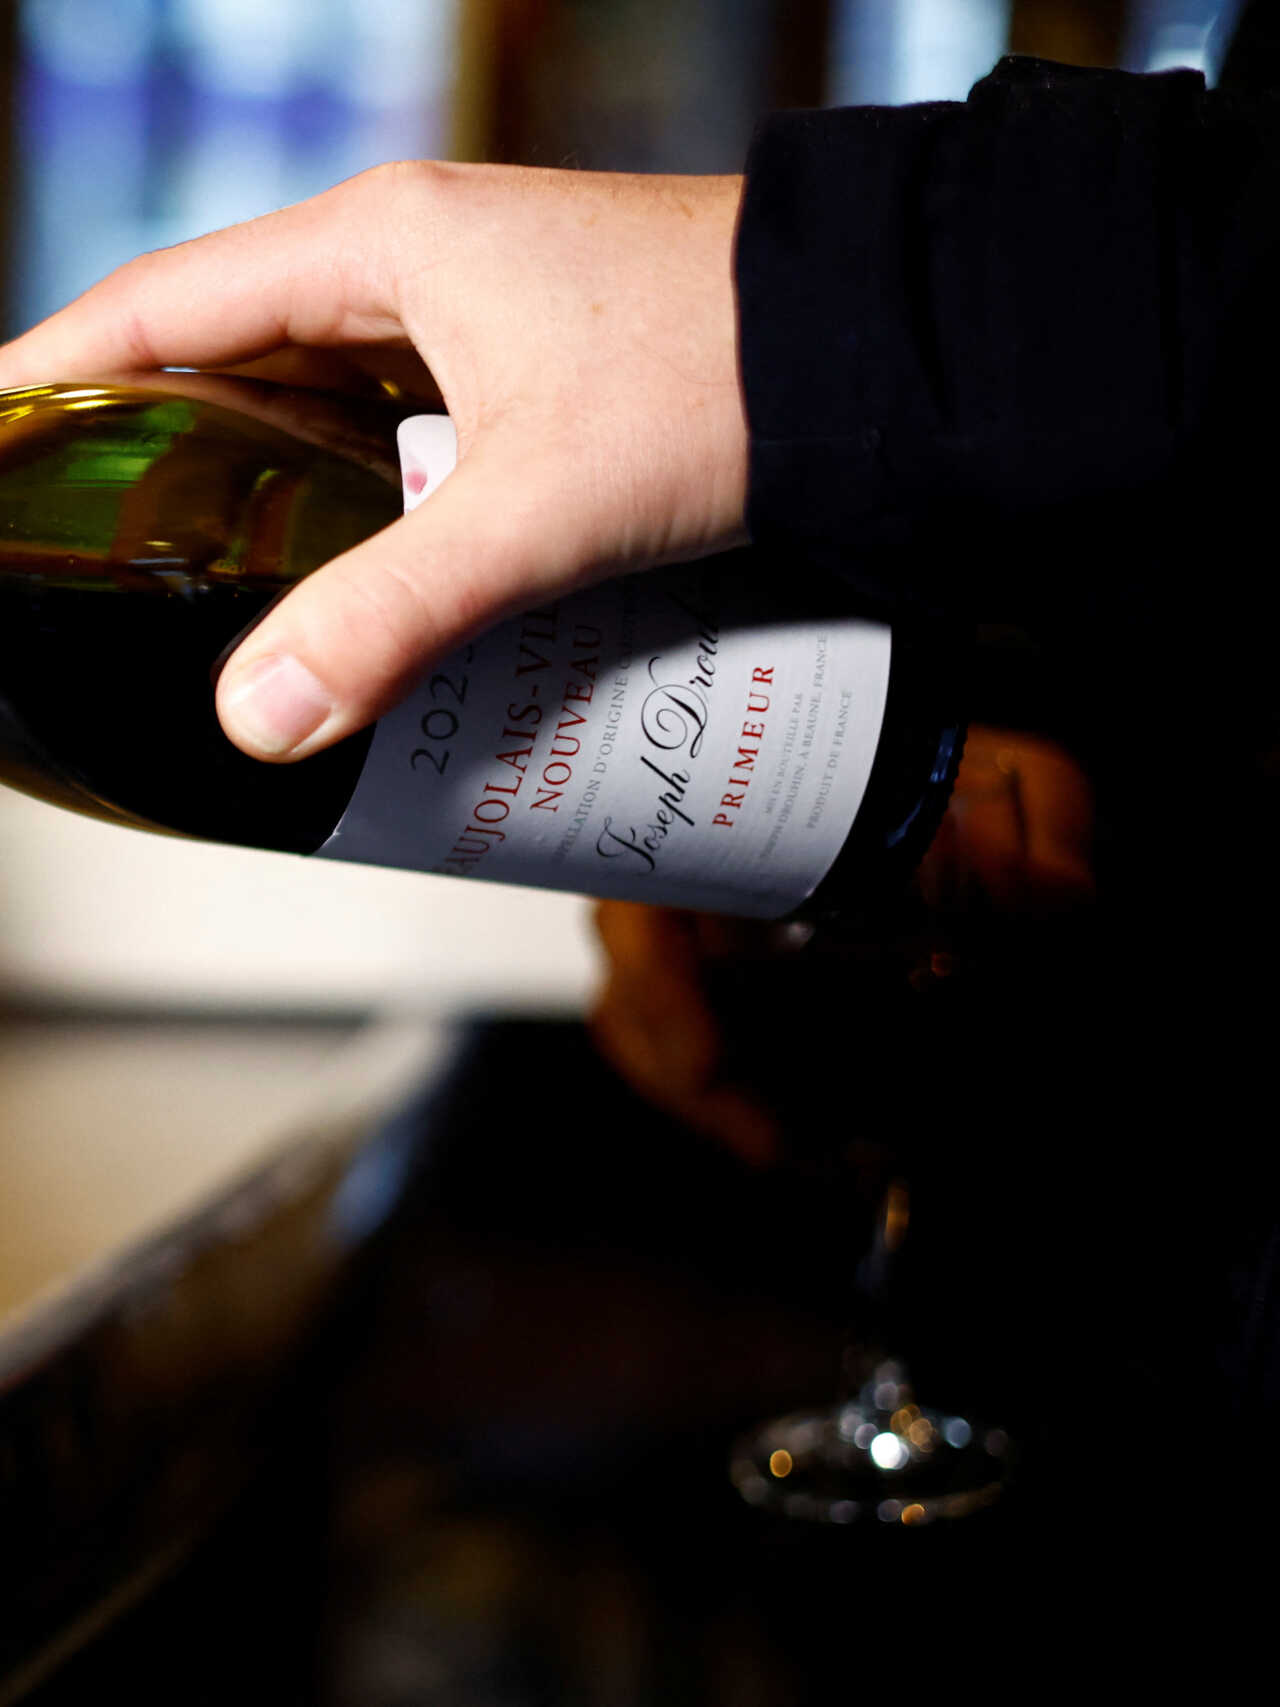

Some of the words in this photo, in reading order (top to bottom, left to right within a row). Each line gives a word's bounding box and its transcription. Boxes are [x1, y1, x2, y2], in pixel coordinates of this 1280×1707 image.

[410, 644, 473, 776] 202
[529, 623, 601, 813] NOUVEAU
[593, 677, 630, 776] D'ORIGINE
[712, 665, 775, 828] PRIMEUR
[807, 770, 834, 830] PRODUIT
[833, 690, 854, 746] FRANCE
[596, 755, 695, 872] Joseph
